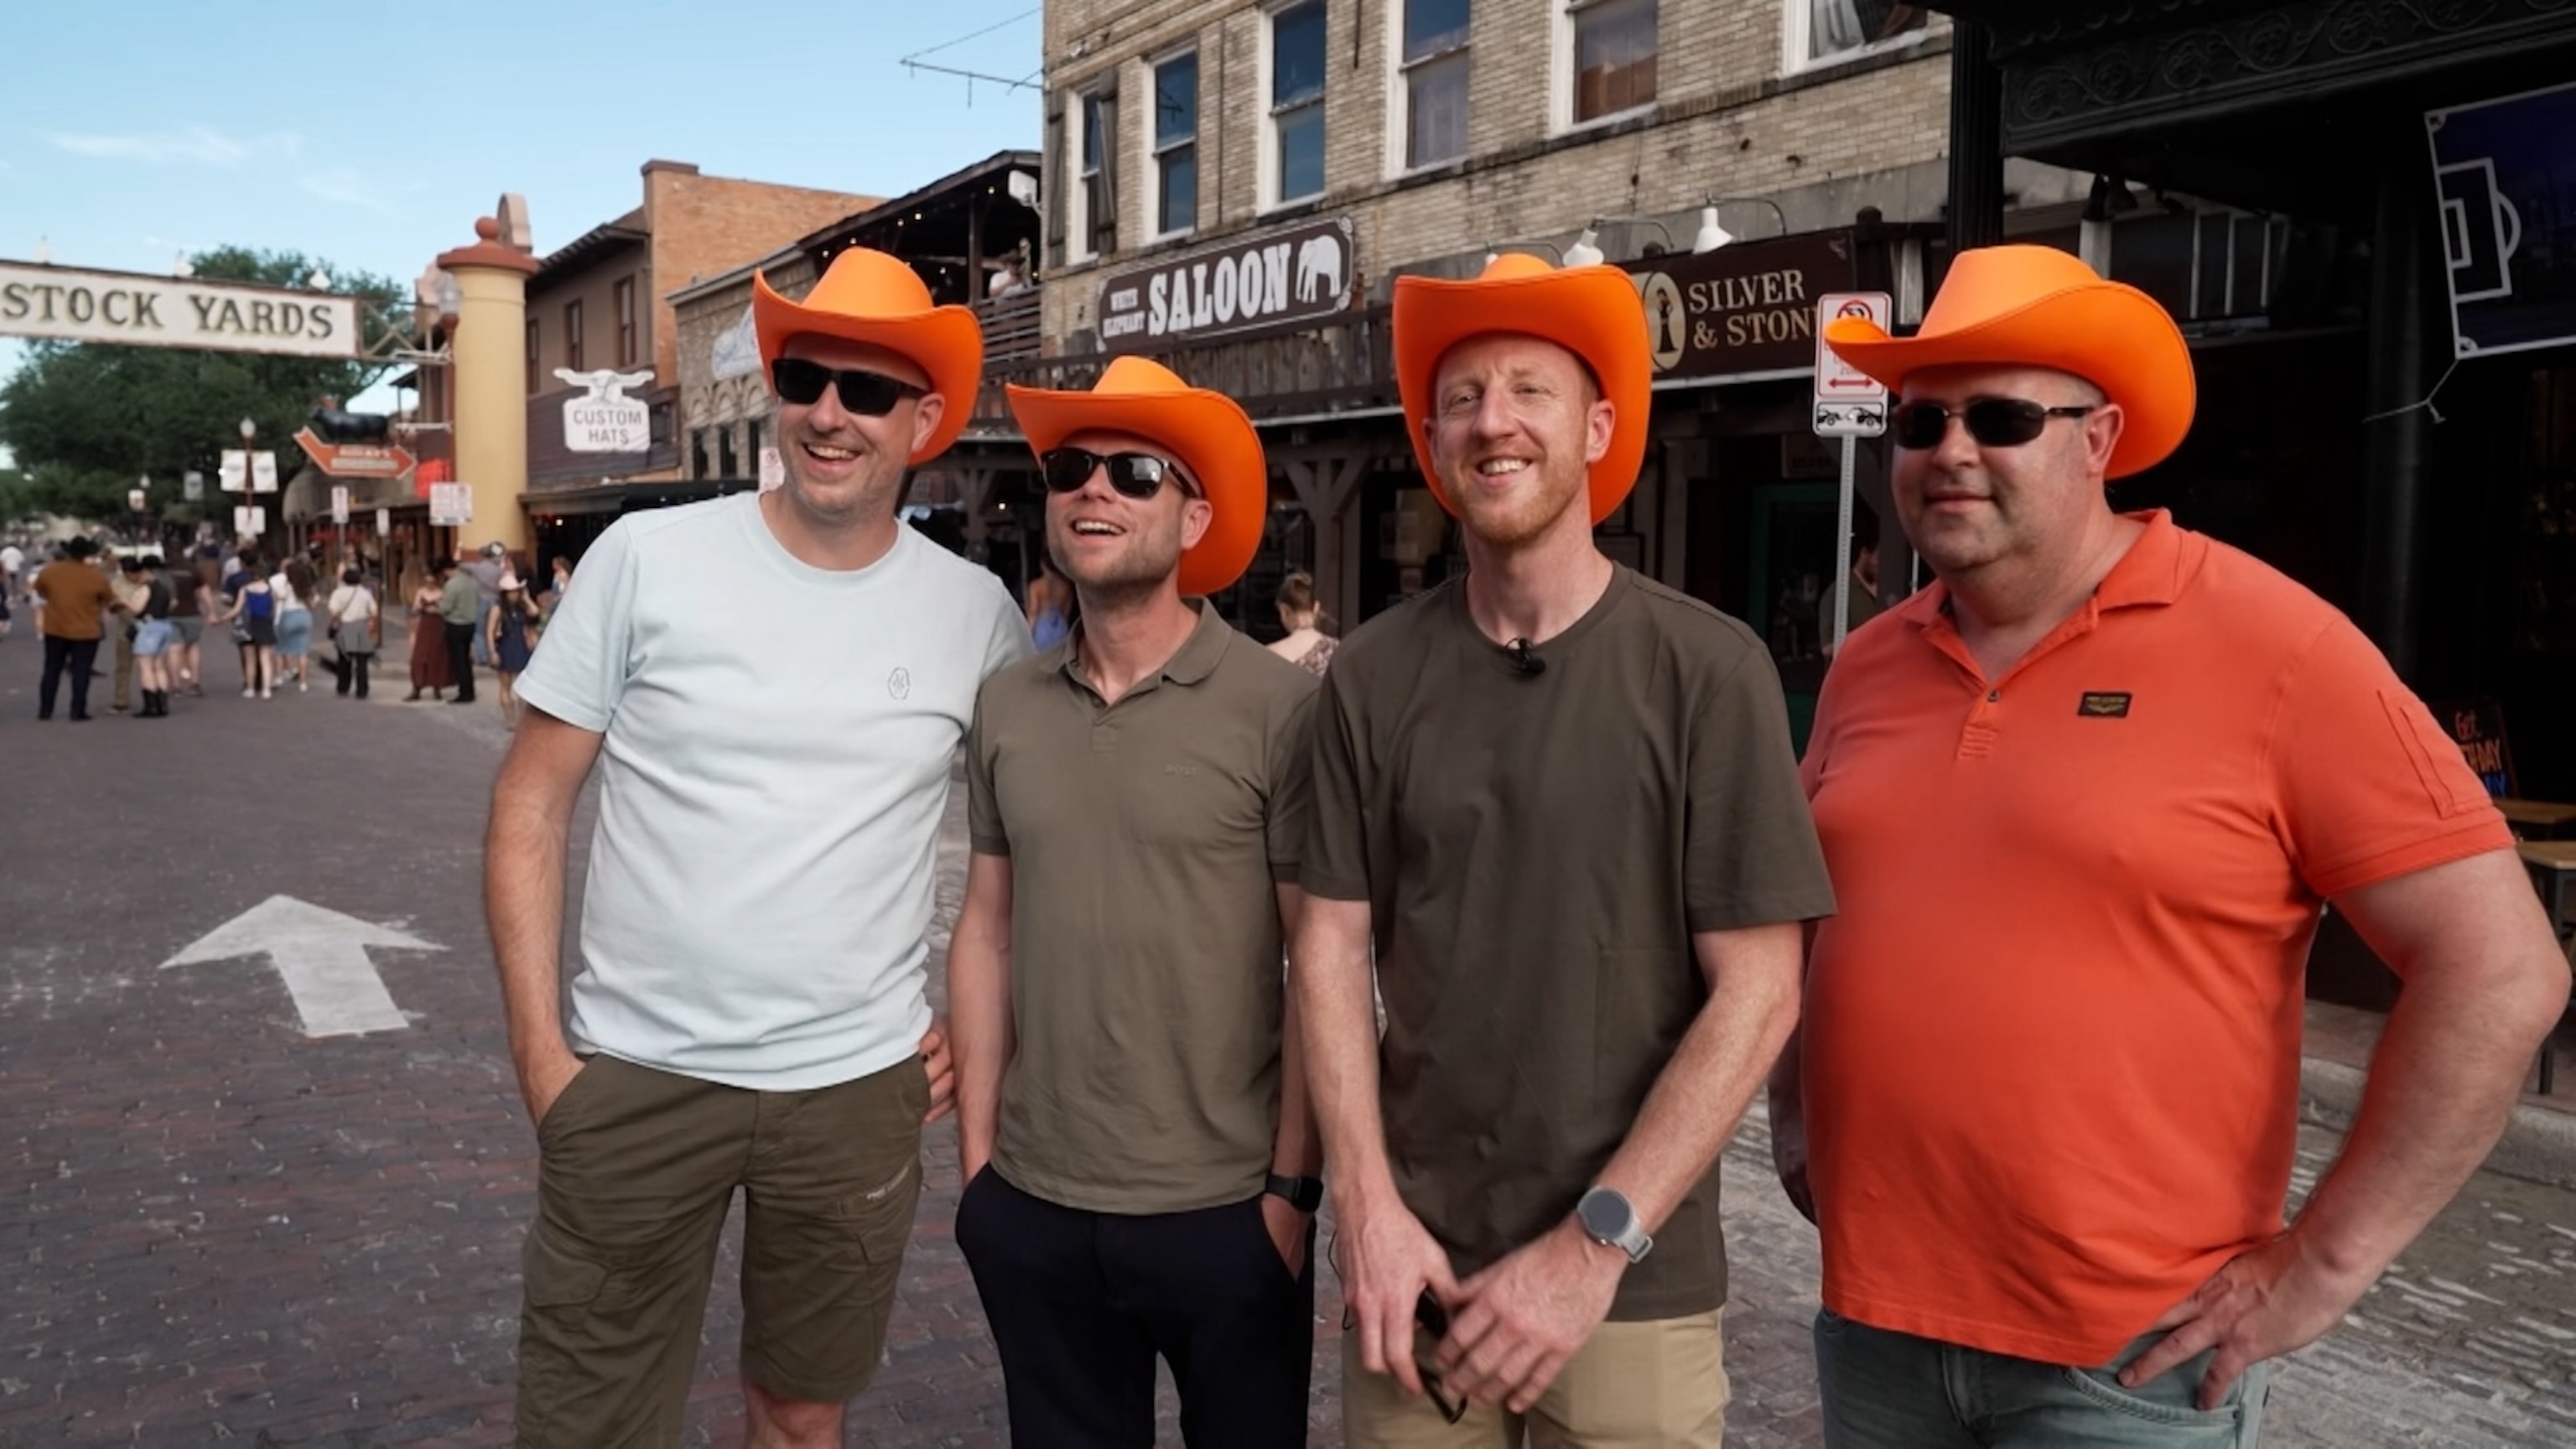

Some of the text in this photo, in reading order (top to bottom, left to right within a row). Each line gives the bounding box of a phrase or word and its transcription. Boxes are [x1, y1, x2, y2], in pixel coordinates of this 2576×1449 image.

[2, 282, 334, 339] STOCK YARDS
[1148, 242, 1291, 336] SALOON
[1688, 269, 1805, 314] SILVER
[1693, 305, 1819, 350] & STON
[573, 409, 642, 425] CUSTOM
[588, 428, 630, 445] HATS
